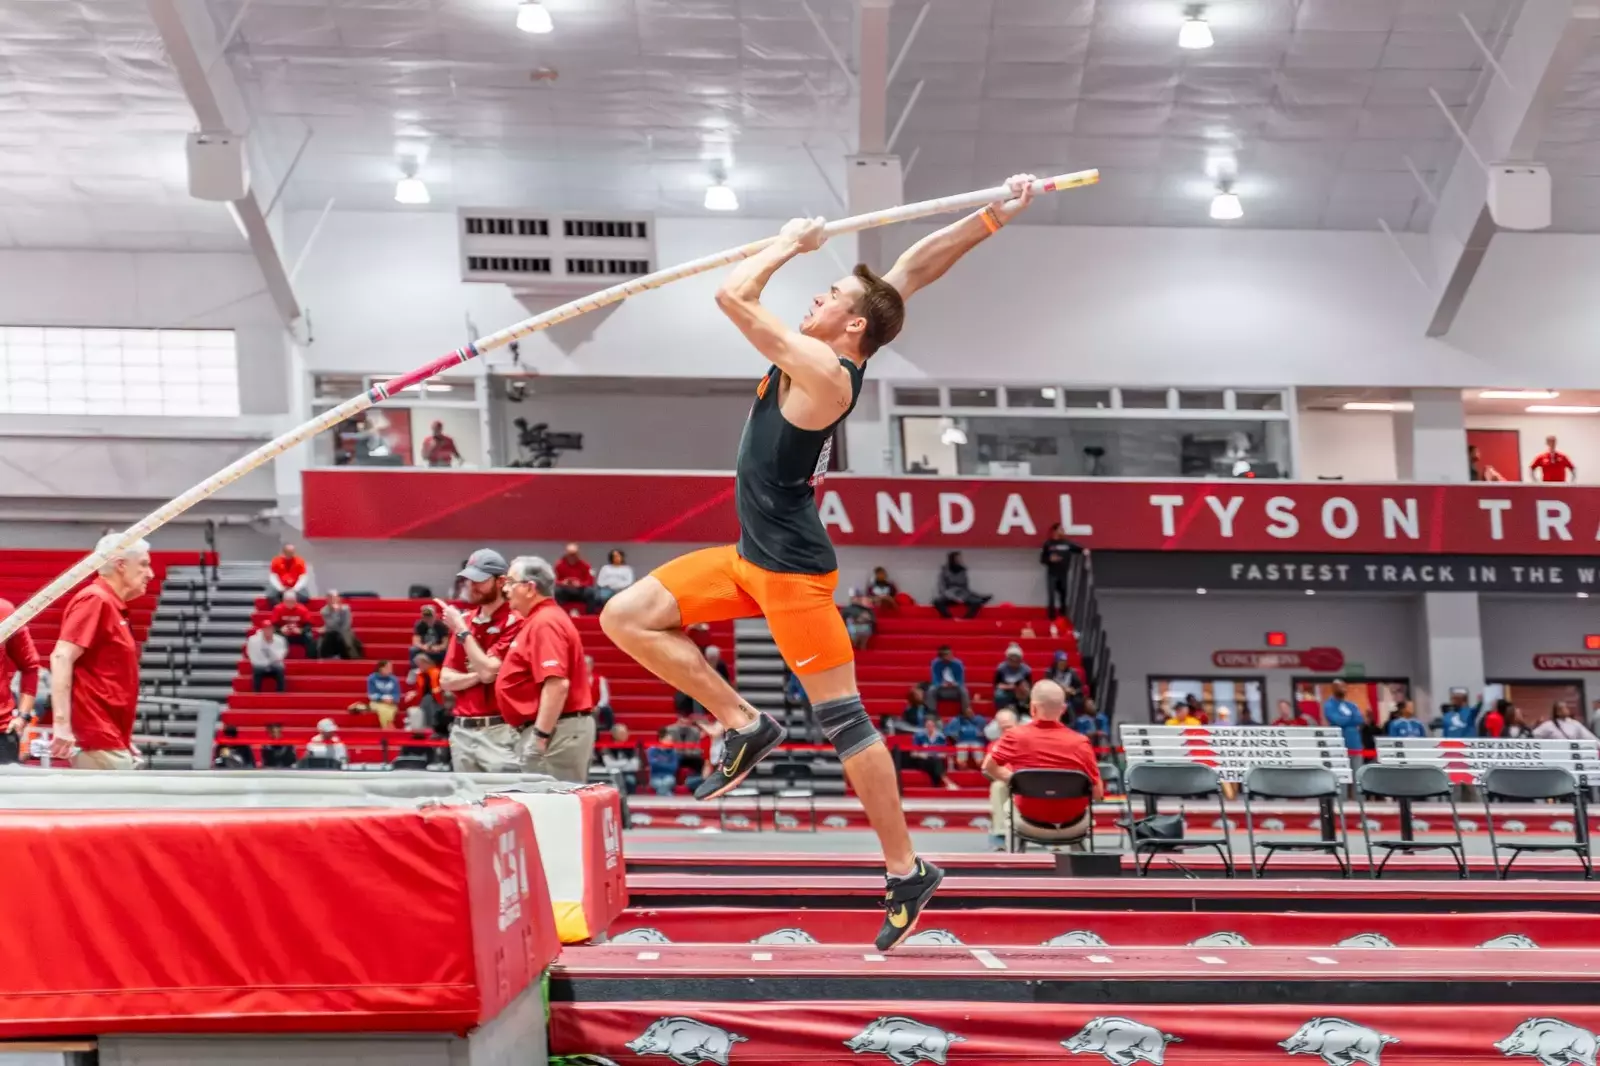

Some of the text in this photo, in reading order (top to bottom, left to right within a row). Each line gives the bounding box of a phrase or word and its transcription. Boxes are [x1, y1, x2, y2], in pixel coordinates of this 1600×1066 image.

[1149, 495, 1420, 539] TYSON
[1479, 499, 1600, 541] TR
[1231, 563, 1600, 583] FASTEST TRACK IN THE W
[1211, 739, 1289, 747] ARKANSAS
